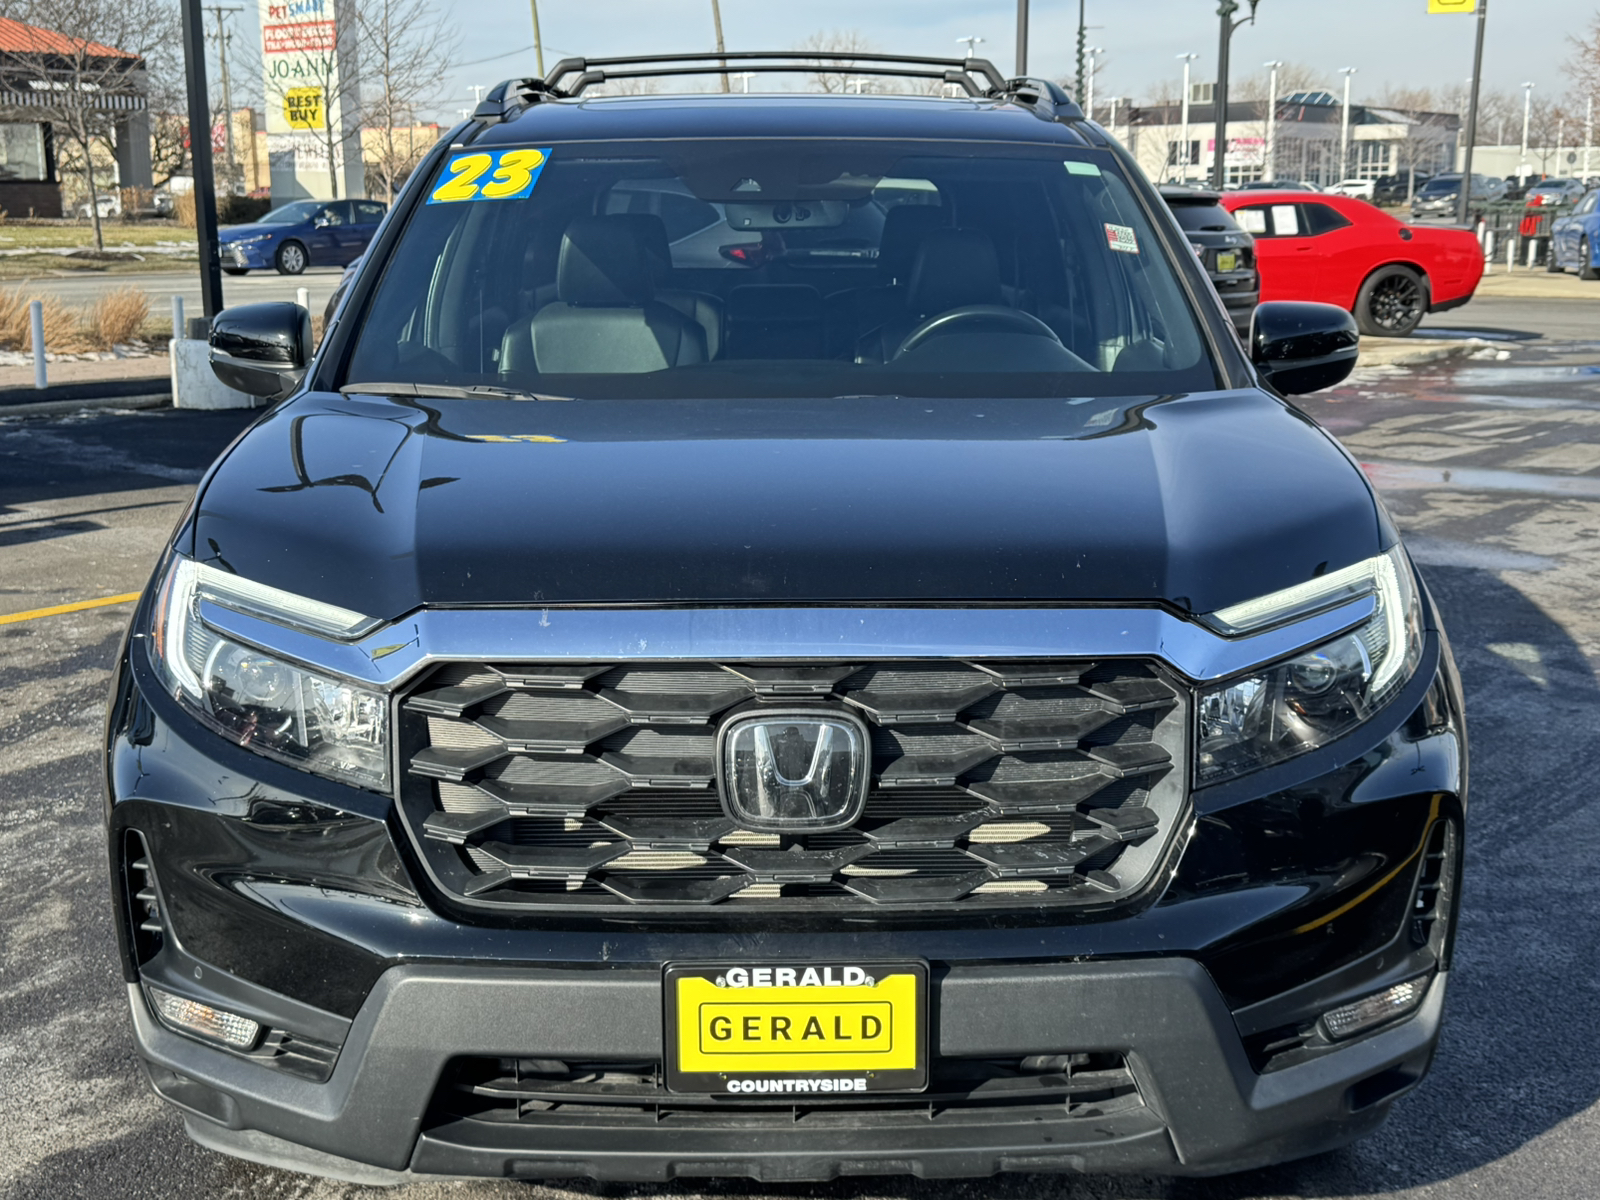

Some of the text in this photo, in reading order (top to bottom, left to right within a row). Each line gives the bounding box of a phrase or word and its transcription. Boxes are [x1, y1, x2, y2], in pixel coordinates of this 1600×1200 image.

[288, 95, 321, 108] BEST
[290, 109, 318, 121] BUY
[433, 149, 544, 202] 23
[726, 967, 865, 988] GERALD
[709, 1015, 882, 1042] GERALD
[727, 1078, 867, 1093] COUNTRYSIDE
